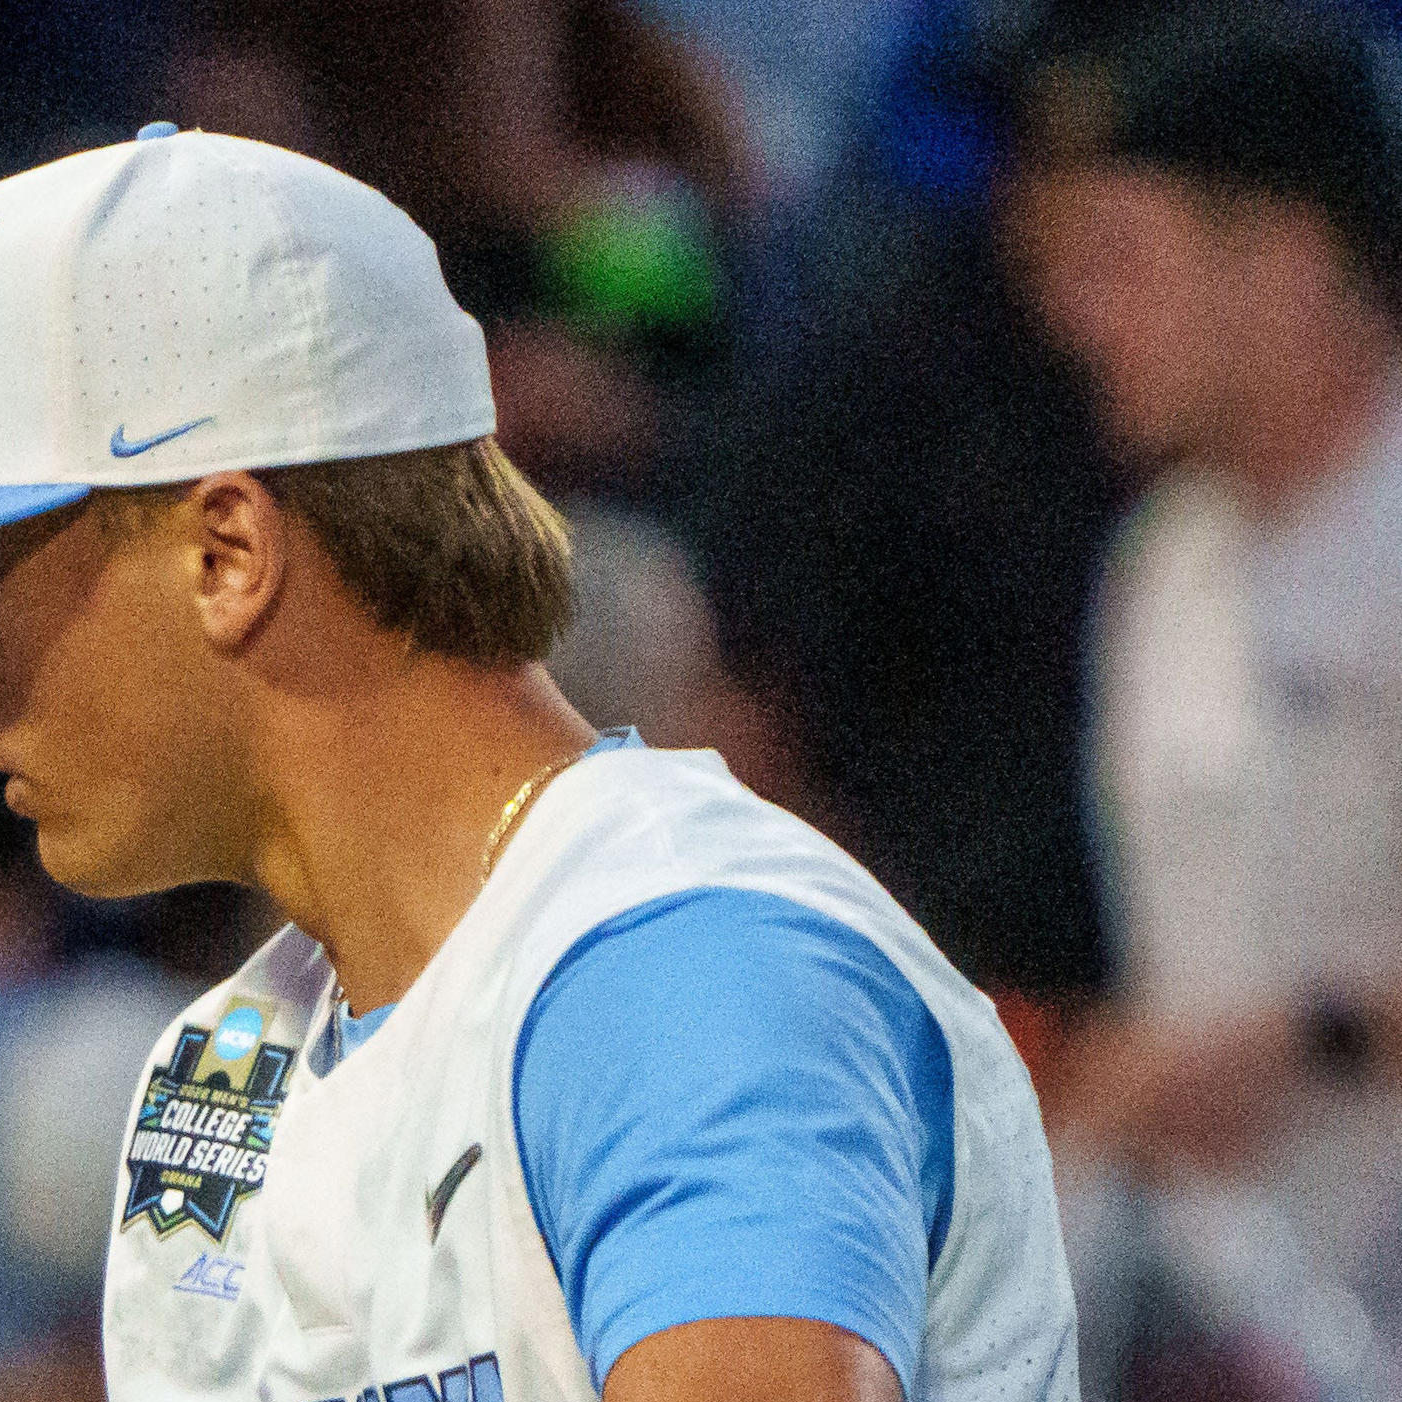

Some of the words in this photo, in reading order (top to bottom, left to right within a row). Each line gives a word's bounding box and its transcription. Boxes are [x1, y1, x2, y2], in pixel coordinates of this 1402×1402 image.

[161, 1100, 251, 1143] COLLEGE
[130, 1131, 187, 1168] WORLD
[188, 1142, 268, 1182] SERIES
[176, 1252, 246, 1296] ACC
